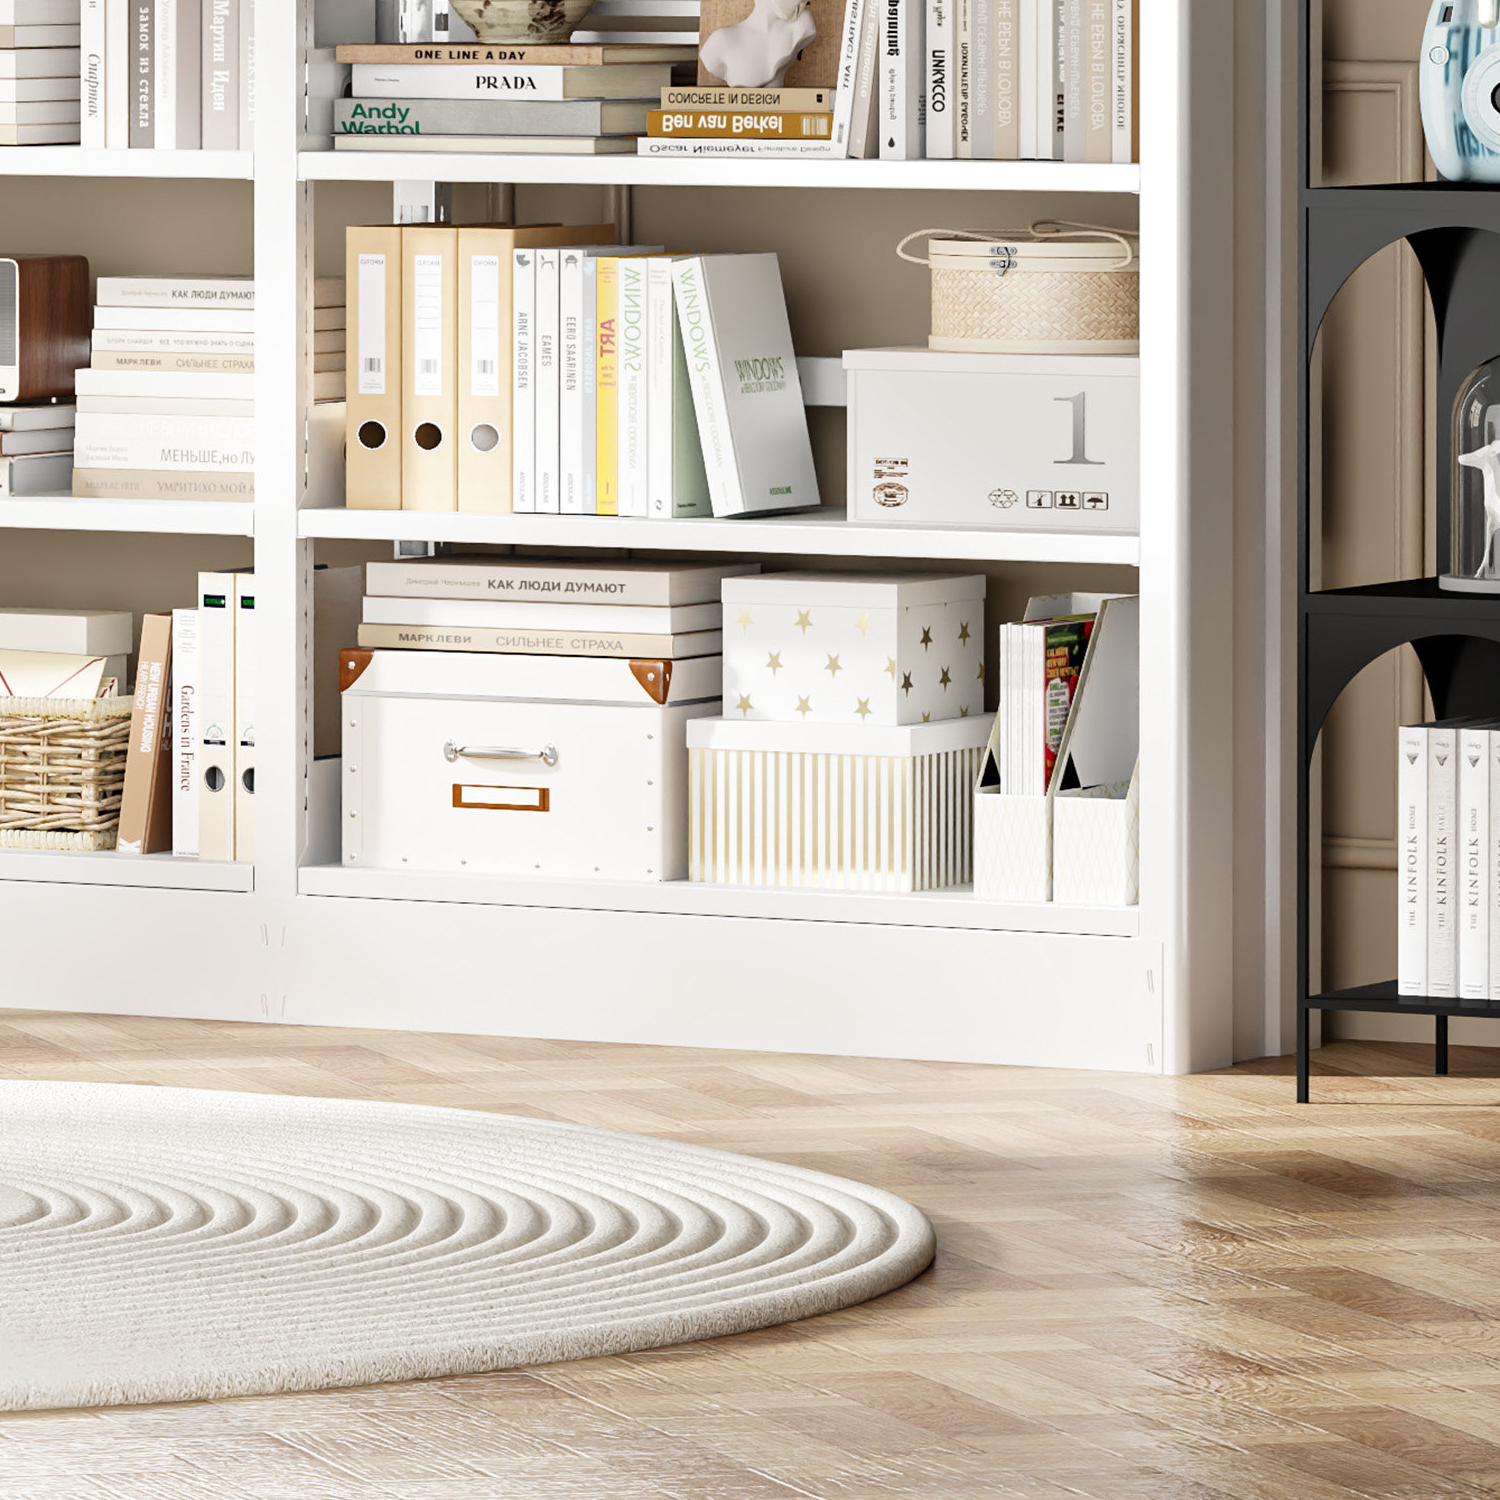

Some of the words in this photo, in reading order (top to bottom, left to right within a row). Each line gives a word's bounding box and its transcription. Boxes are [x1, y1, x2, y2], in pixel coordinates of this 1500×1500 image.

[209, 0, 229, 62] Мартин
[414, 49, 443, 60] ONE
[448, 49, 480, 60] LINE
[485, 50, 495, 60] A
[498, 50, 526, 61] DAY
[85, 53, 101, 118] Спартак
[210, 69, 229, 111] Иден
[475, 75, 537, 90] PRADA
[341, 120, 420, 134] Warhol
[351, 102, 410, 123] Andy
[518, 311, 528, 337] ARNE
[566, 316, 576, 340] EERO
[678, 268, 711, 373] WINDOWS
[518, 340, 528, 389] JACOBSEN
[541, 334, 552, 367] EAMES
[566, 343, 576, 391] SAARINEN
[734, 356, 785, 381] WINDOWS
[1053, 391, 1106, 465] 1
[487, 579, 514, 590] КАК
[518, 579, 562, 592] ЛЮДИ
[564, 581, 627, 594] ДУМАЮТ
[398, 632, 434, 642] МАРК
[436, 634, 472, 643] ЛЕВИ
[495, 635, 564, 649] СИЛЬНЕЕ
[570, 638, 623, 651] СТРАХА
[138, 660, 149, 683] HILARY
[149, 661, 162, 682] NEW
[135, 683, 146, 710] FRENCH
[145, 682, 159, 713] URBAN
[180, 684, 195, 733] Gardens
[140, 714, 154, 753] HOUSING
[180, 736, 194, 748] in
[180, 751, 194, 791] France
[1408, 804, 1416, 830] HOME
[1407, 834, 1418, 905] KINFOLK
[1436, 835, 1447, 906] KINFOLK
[1468, 837, 1479, 907] KINFOLK
[1408, 909, 1416, 927] THE
